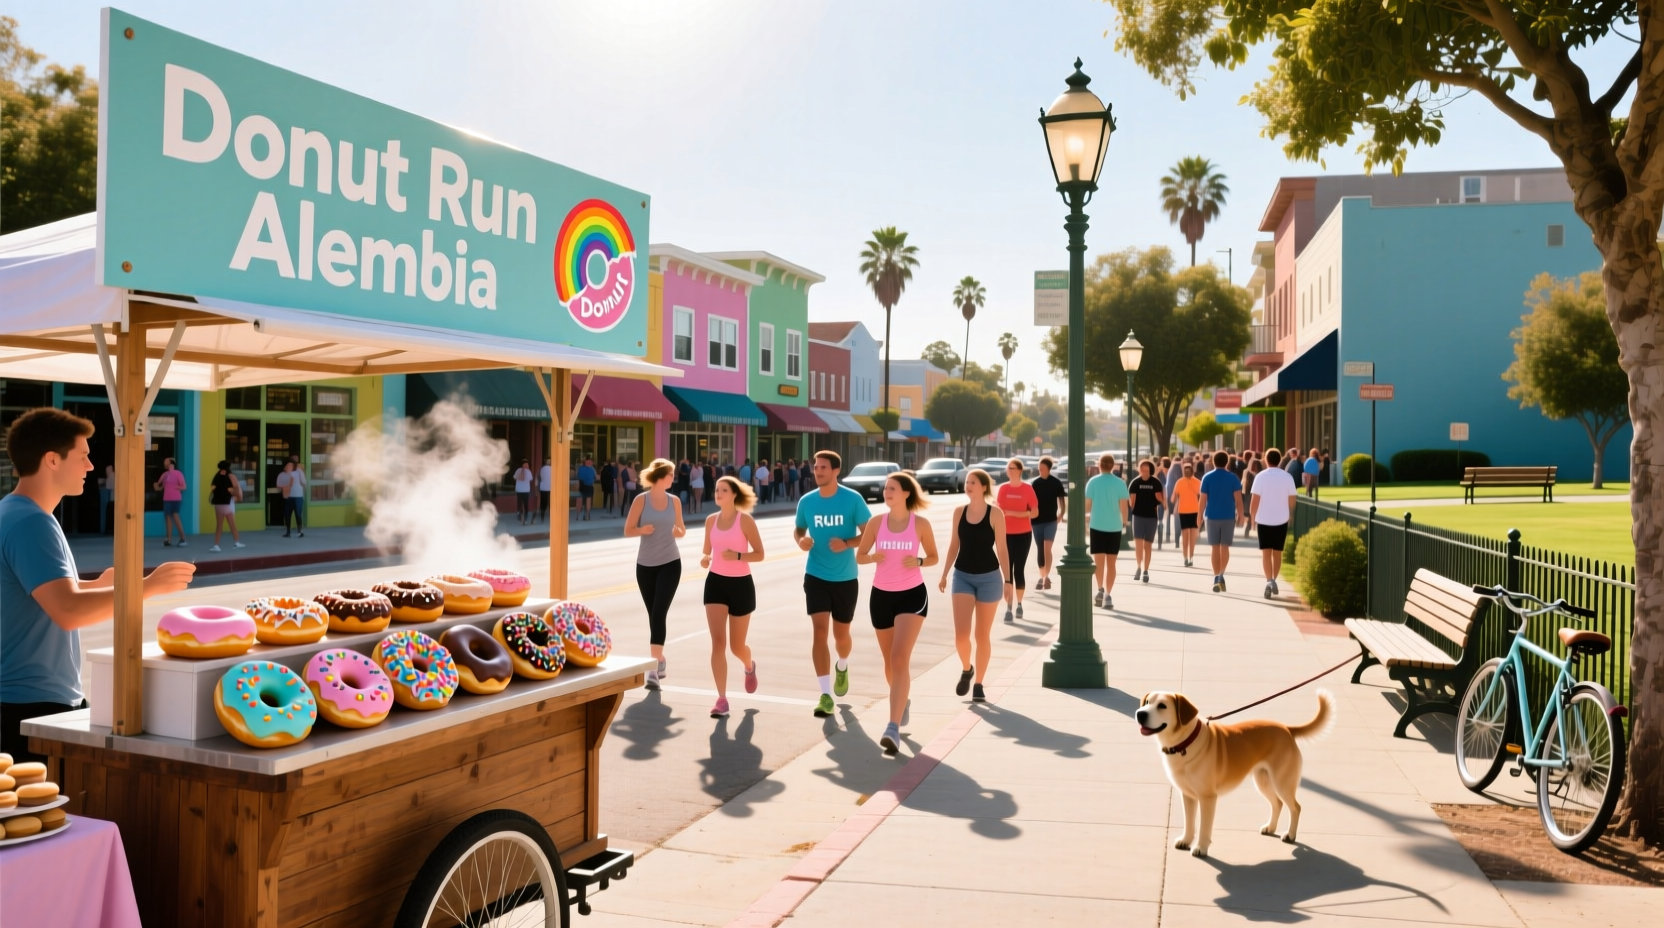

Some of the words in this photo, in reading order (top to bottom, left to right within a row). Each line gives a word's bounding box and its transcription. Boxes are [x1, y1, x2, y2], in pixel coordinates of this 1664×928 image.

[162, 63, 410, 215] Donut
[428, 147, 537, 244] Run
[229, 190, 498, 311] Alembia
